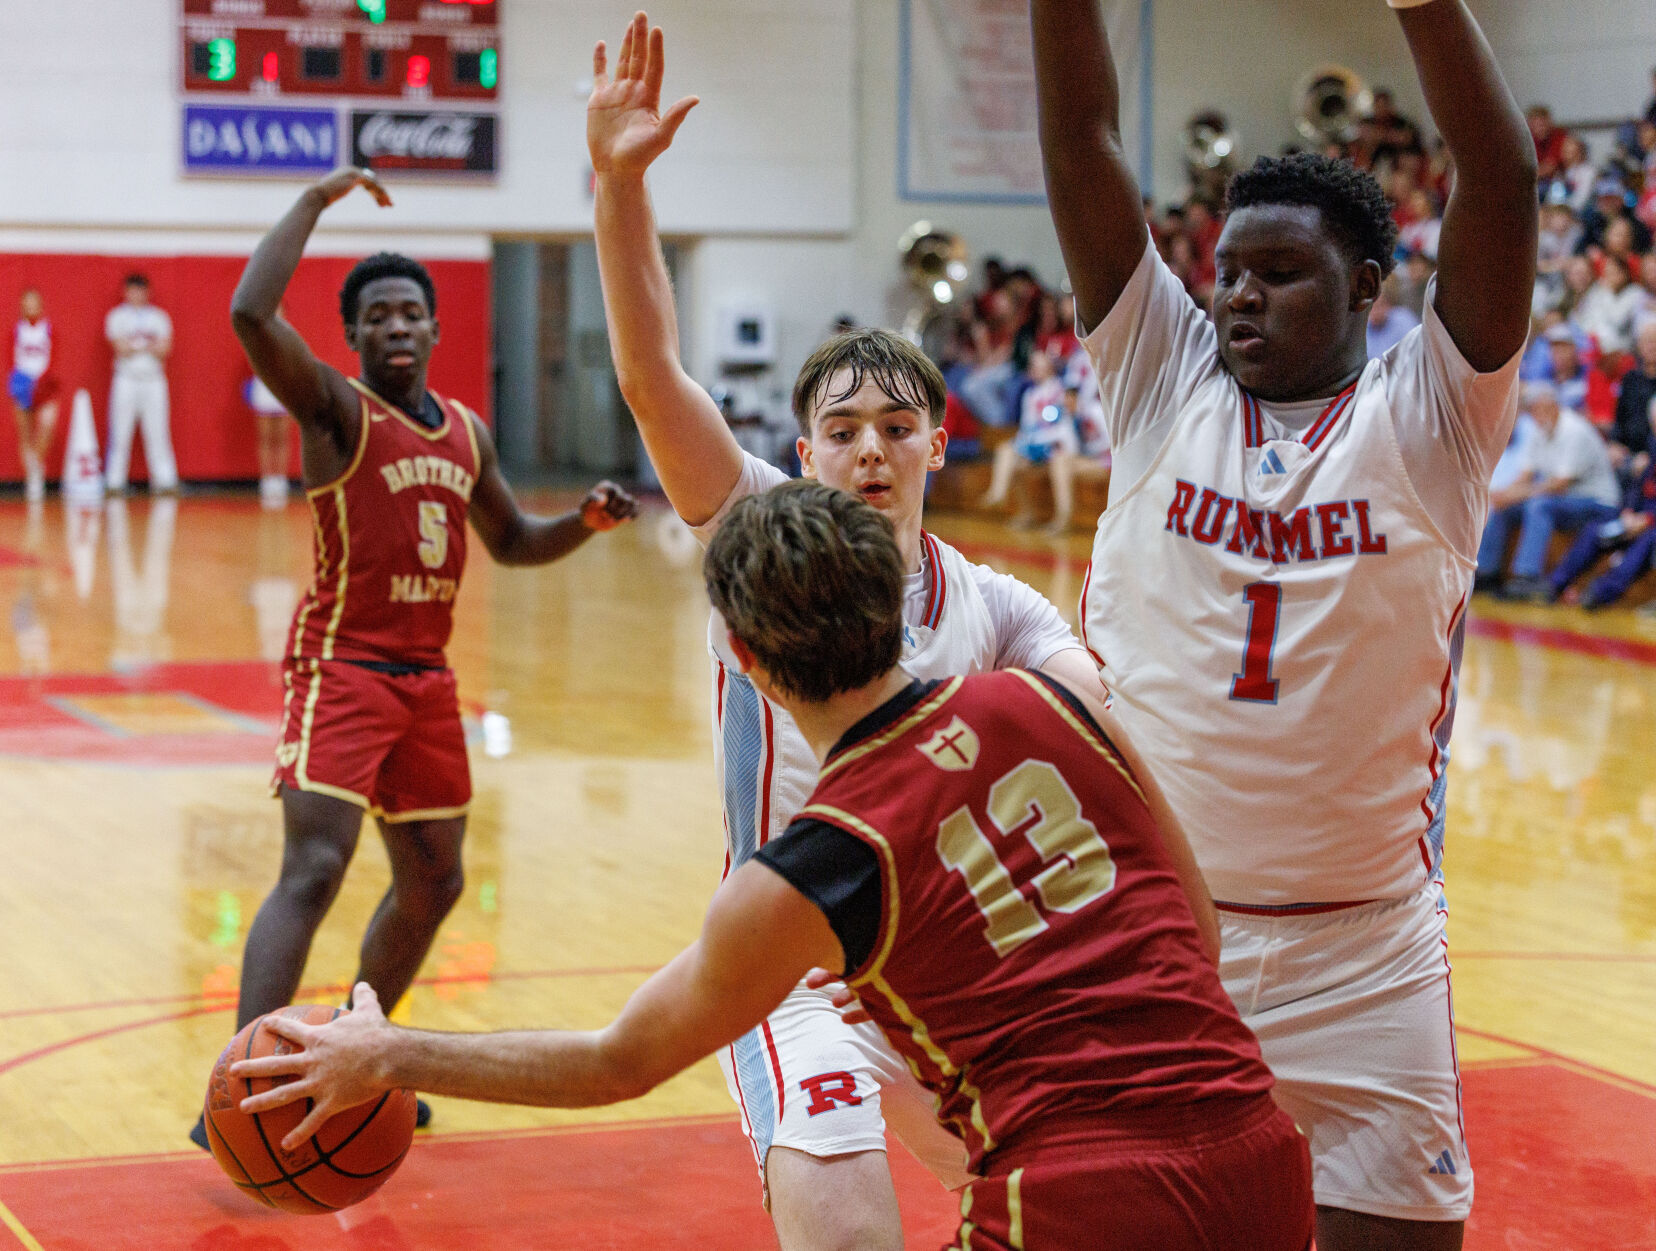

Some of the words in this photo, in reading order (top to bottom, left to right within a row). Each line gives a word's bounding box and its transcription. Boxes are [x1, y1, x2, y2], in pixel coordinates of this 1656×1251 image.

[188, 116, 333, 161] DASANI
[418, 501, 448, 569] 5
[1164, 477, 1388, 565] RUMMEL
[1229, 581, 1282, 705] 1
[936, 758, 1117, 958] 13
[798, 1070, 865, 1119] R
